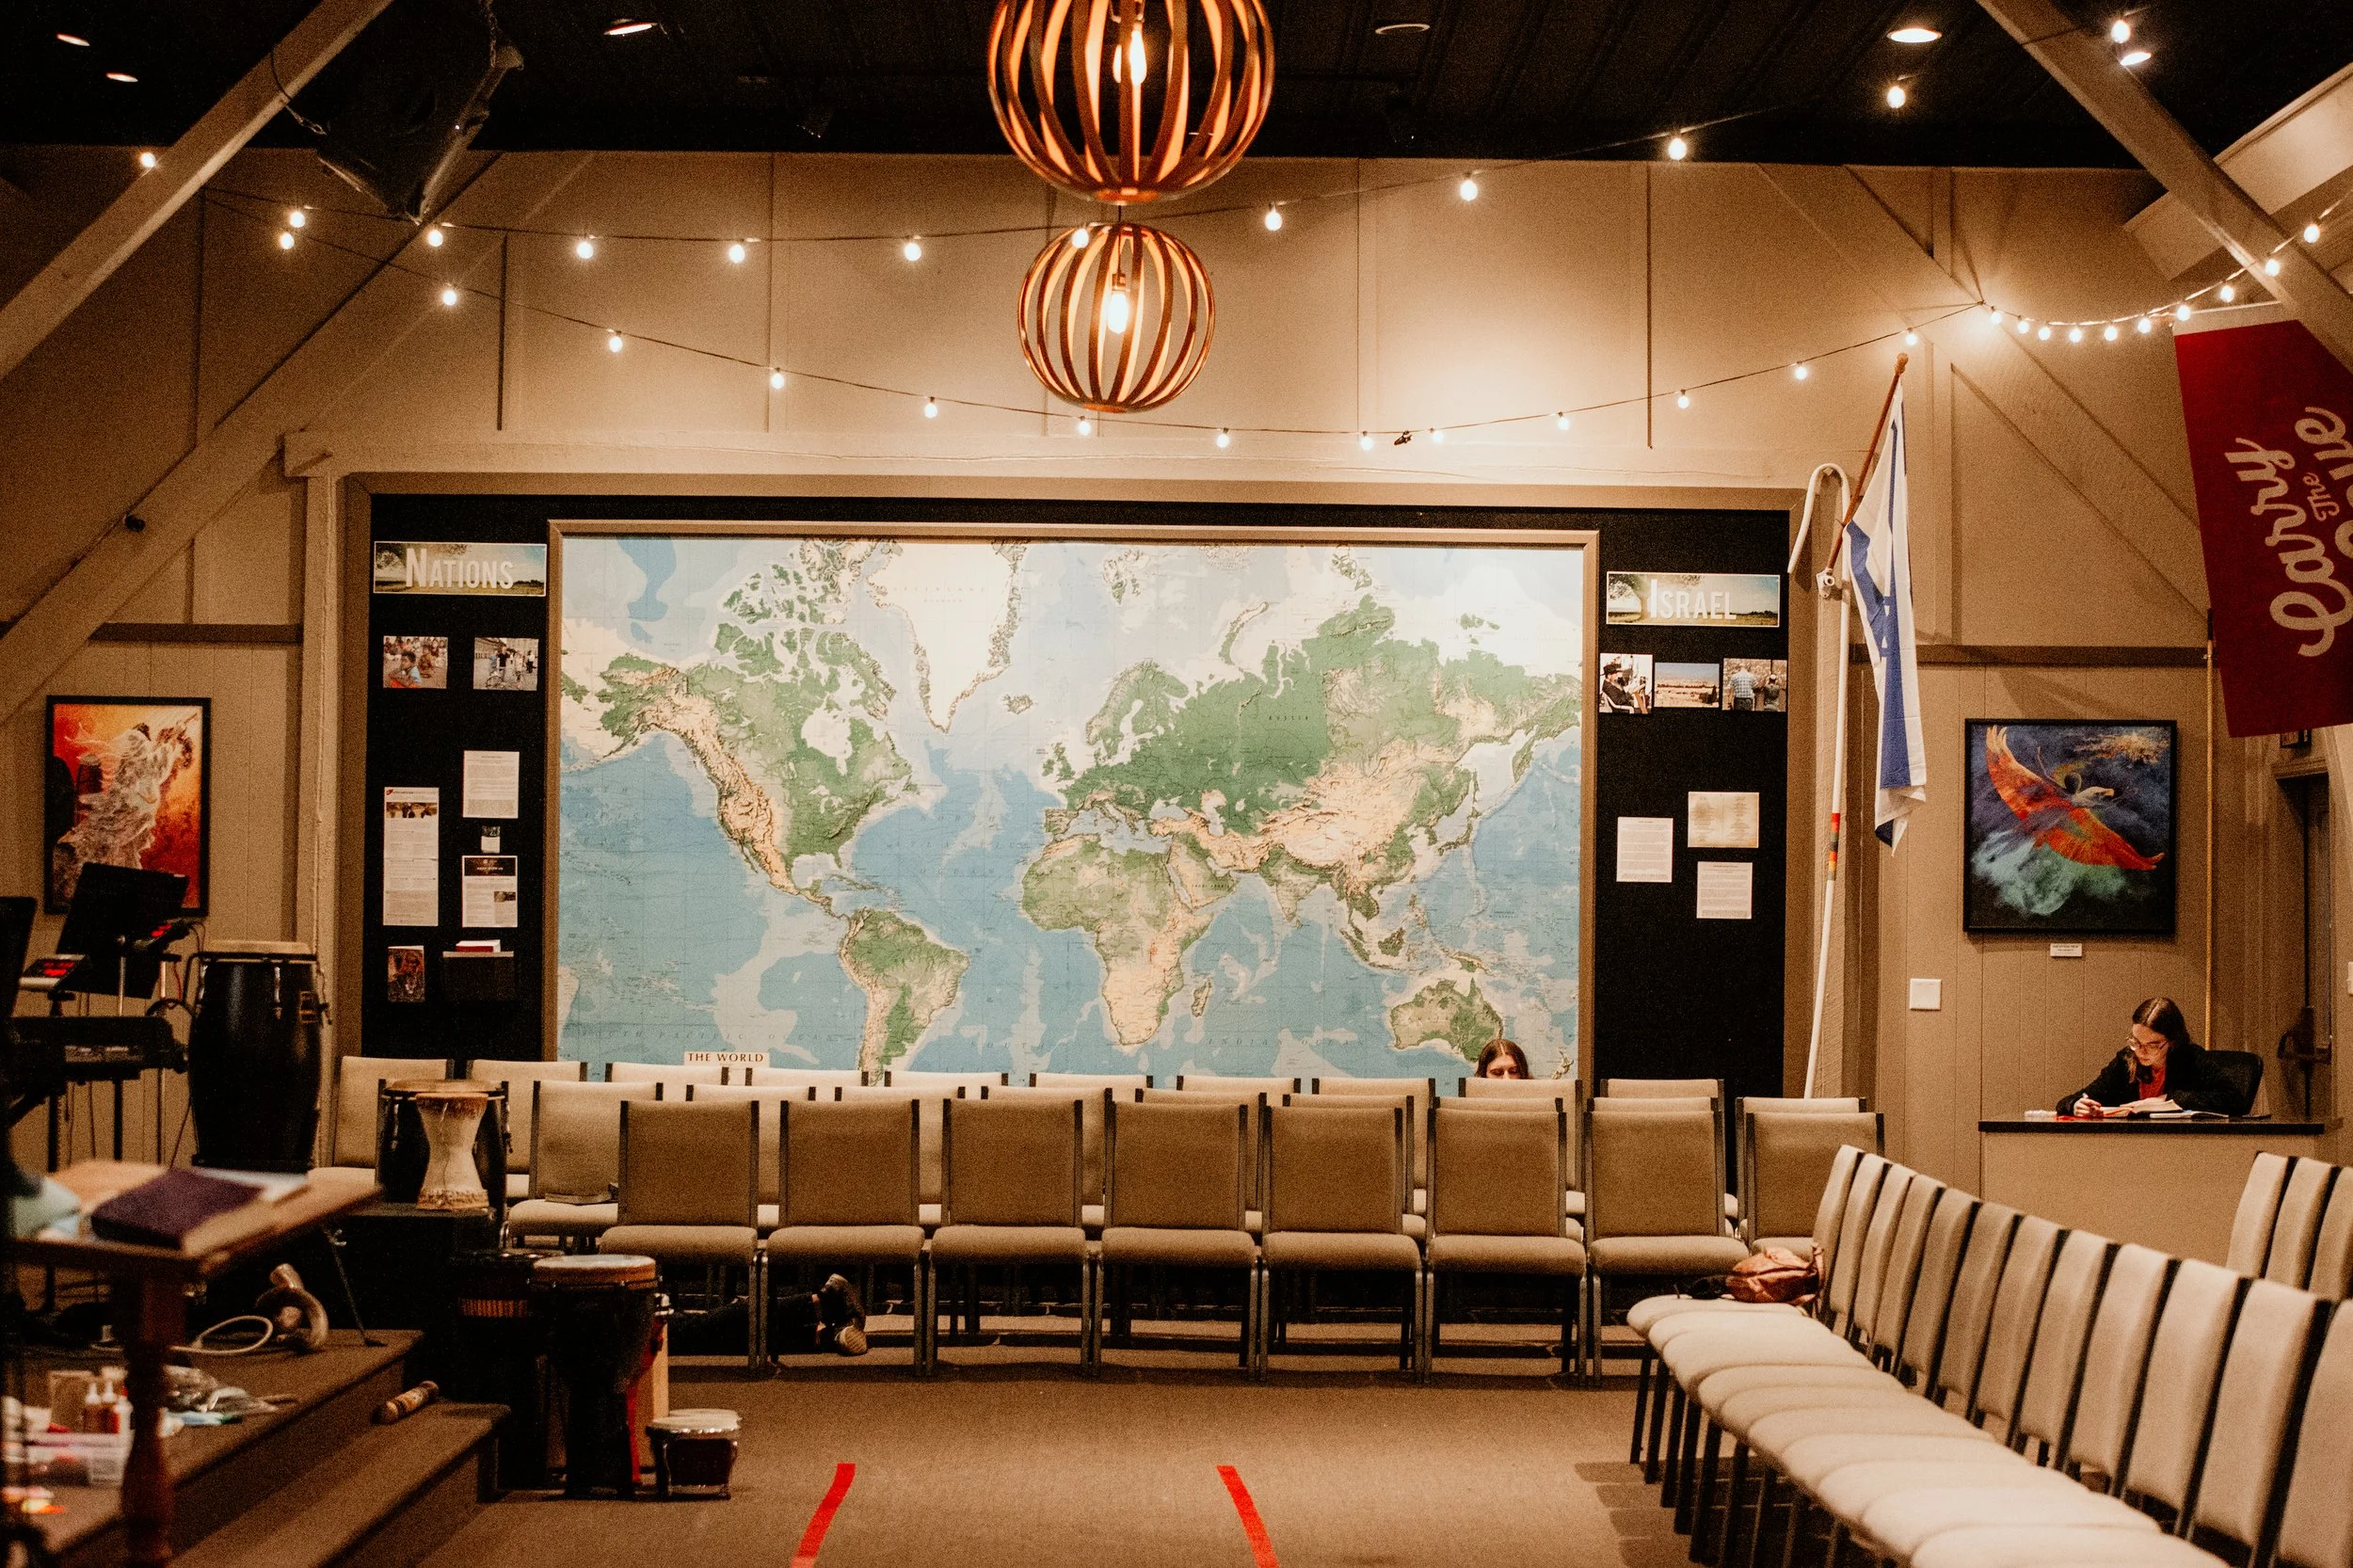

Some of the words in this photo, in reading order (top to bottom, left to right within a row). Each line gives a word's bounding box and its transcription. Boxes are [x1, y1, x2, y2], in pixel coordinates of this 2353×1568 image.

[2303, 472, 2340, 521] The
[2224, 438, 2353, 657] Carry
[406, 548, 514, 589] NATIONS
[1649, 579, 1737, 620] ISRAEL
[688, 1052, 711, 1062] THE
[717, 1052, 764, 1063] WORLD
